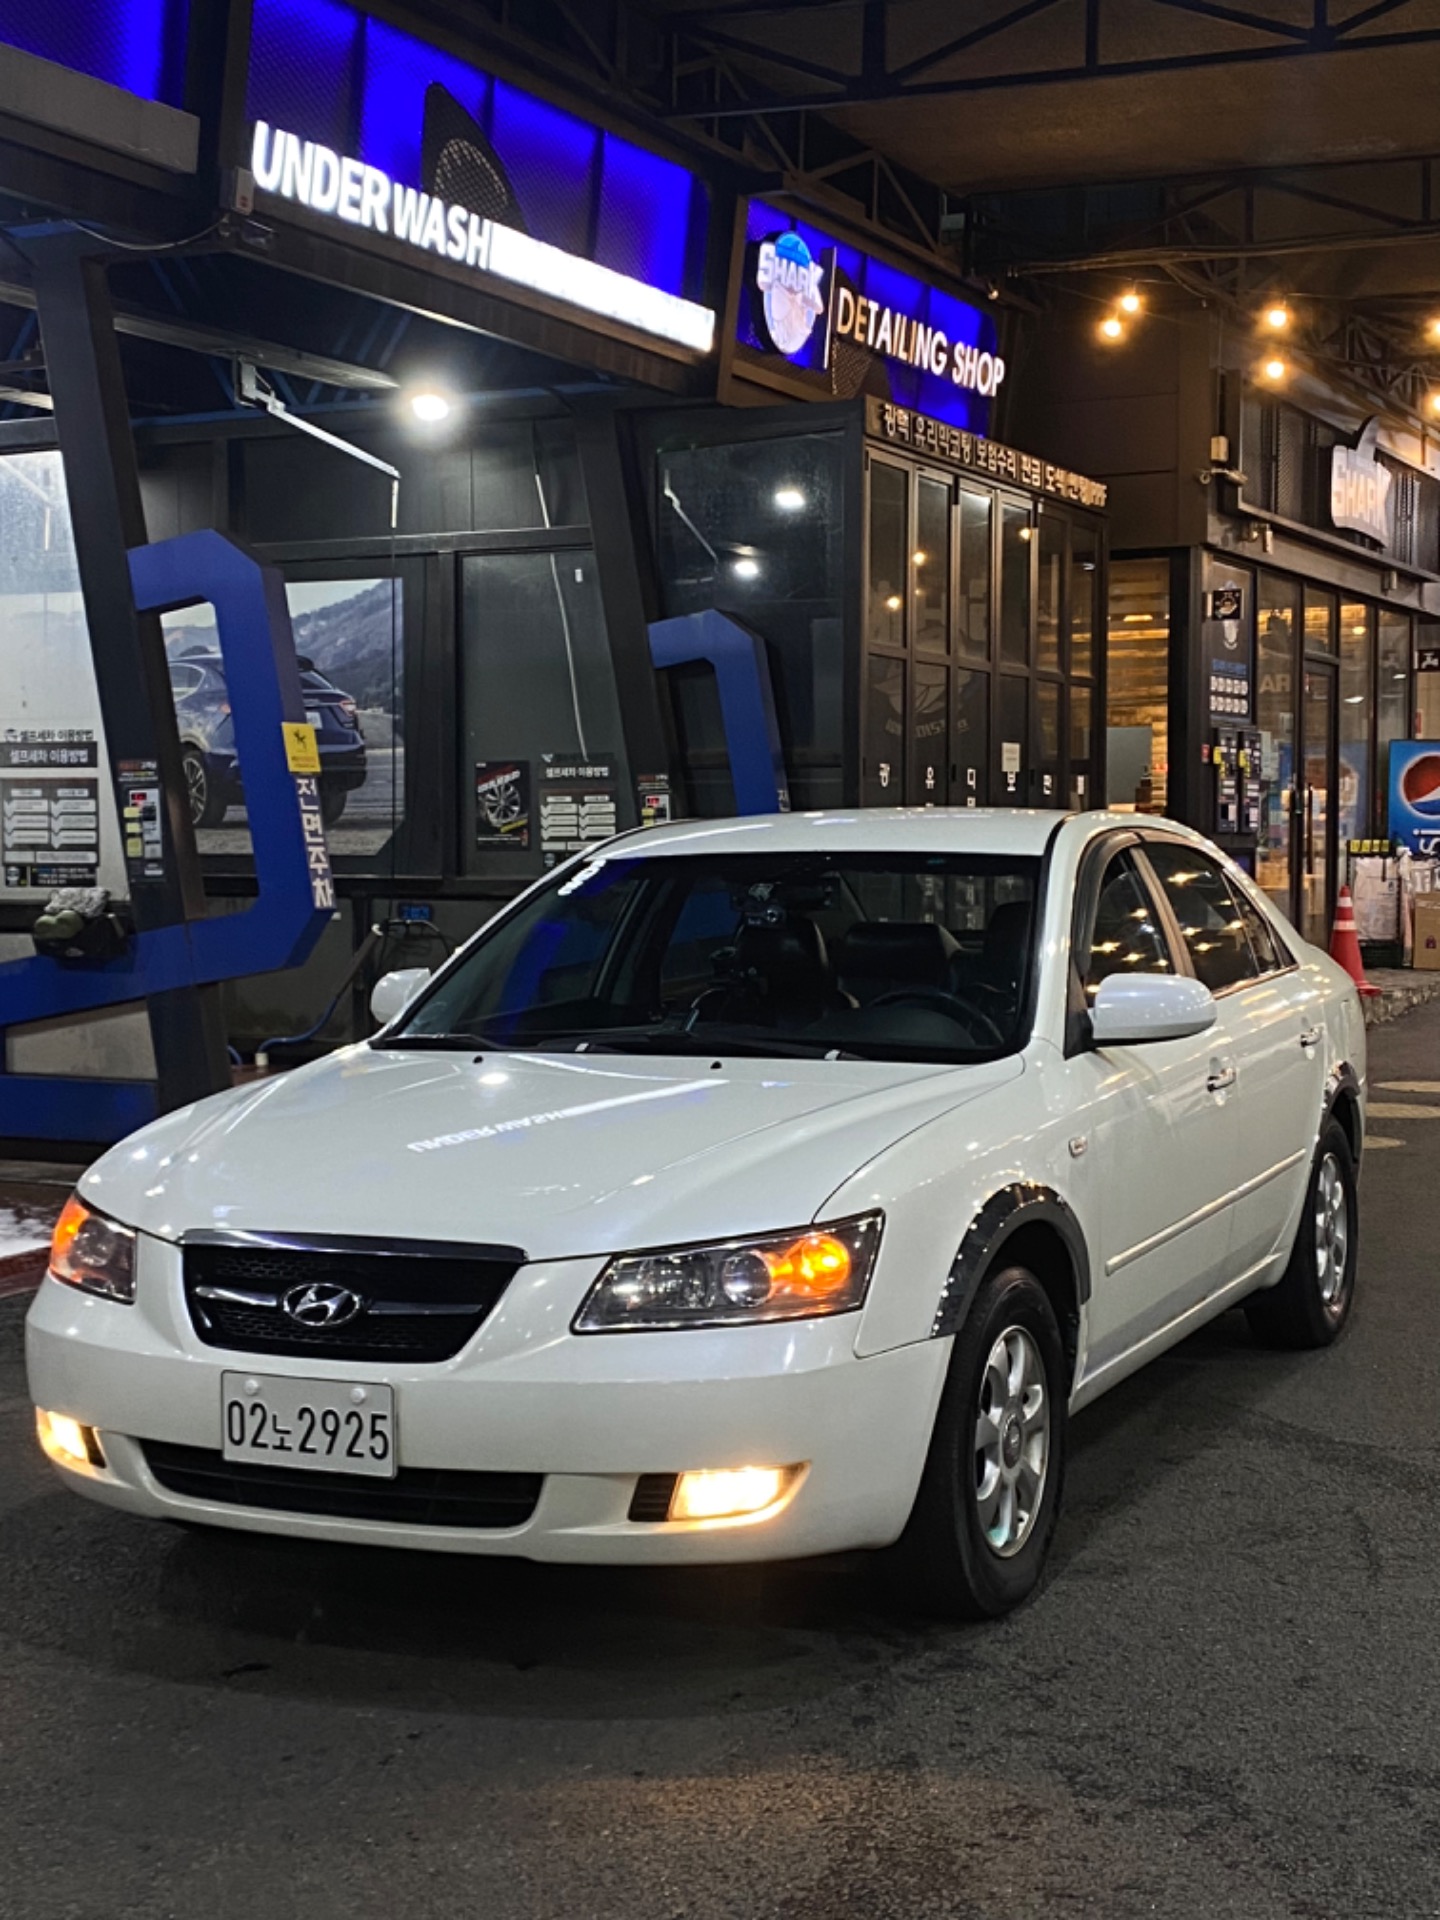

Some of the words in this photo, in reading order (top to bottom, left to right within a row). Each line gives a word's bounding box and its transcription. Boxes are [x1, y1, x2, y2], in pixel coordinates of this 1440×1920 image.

[253, 120, 388, 233] UNDER
[393, 182, 491, 270] WASH
[757, 241, 825, 310] SHARK
[836, 287, 948, 376] DETAILING
[951, 341, 1005, 397] SHOP
[885, 403, 909, 441] 광택
[914, 416, 970, 464] 유리막코팅
[976, 440, 1017, 479] 보험수리
[1021, 455, 1041, 487] 판금
[1332, 444, 1392, 544] SHARK
[296, 778, 334, 909] 전면주차
[228, 1400, 389, 1460] 02노2925
